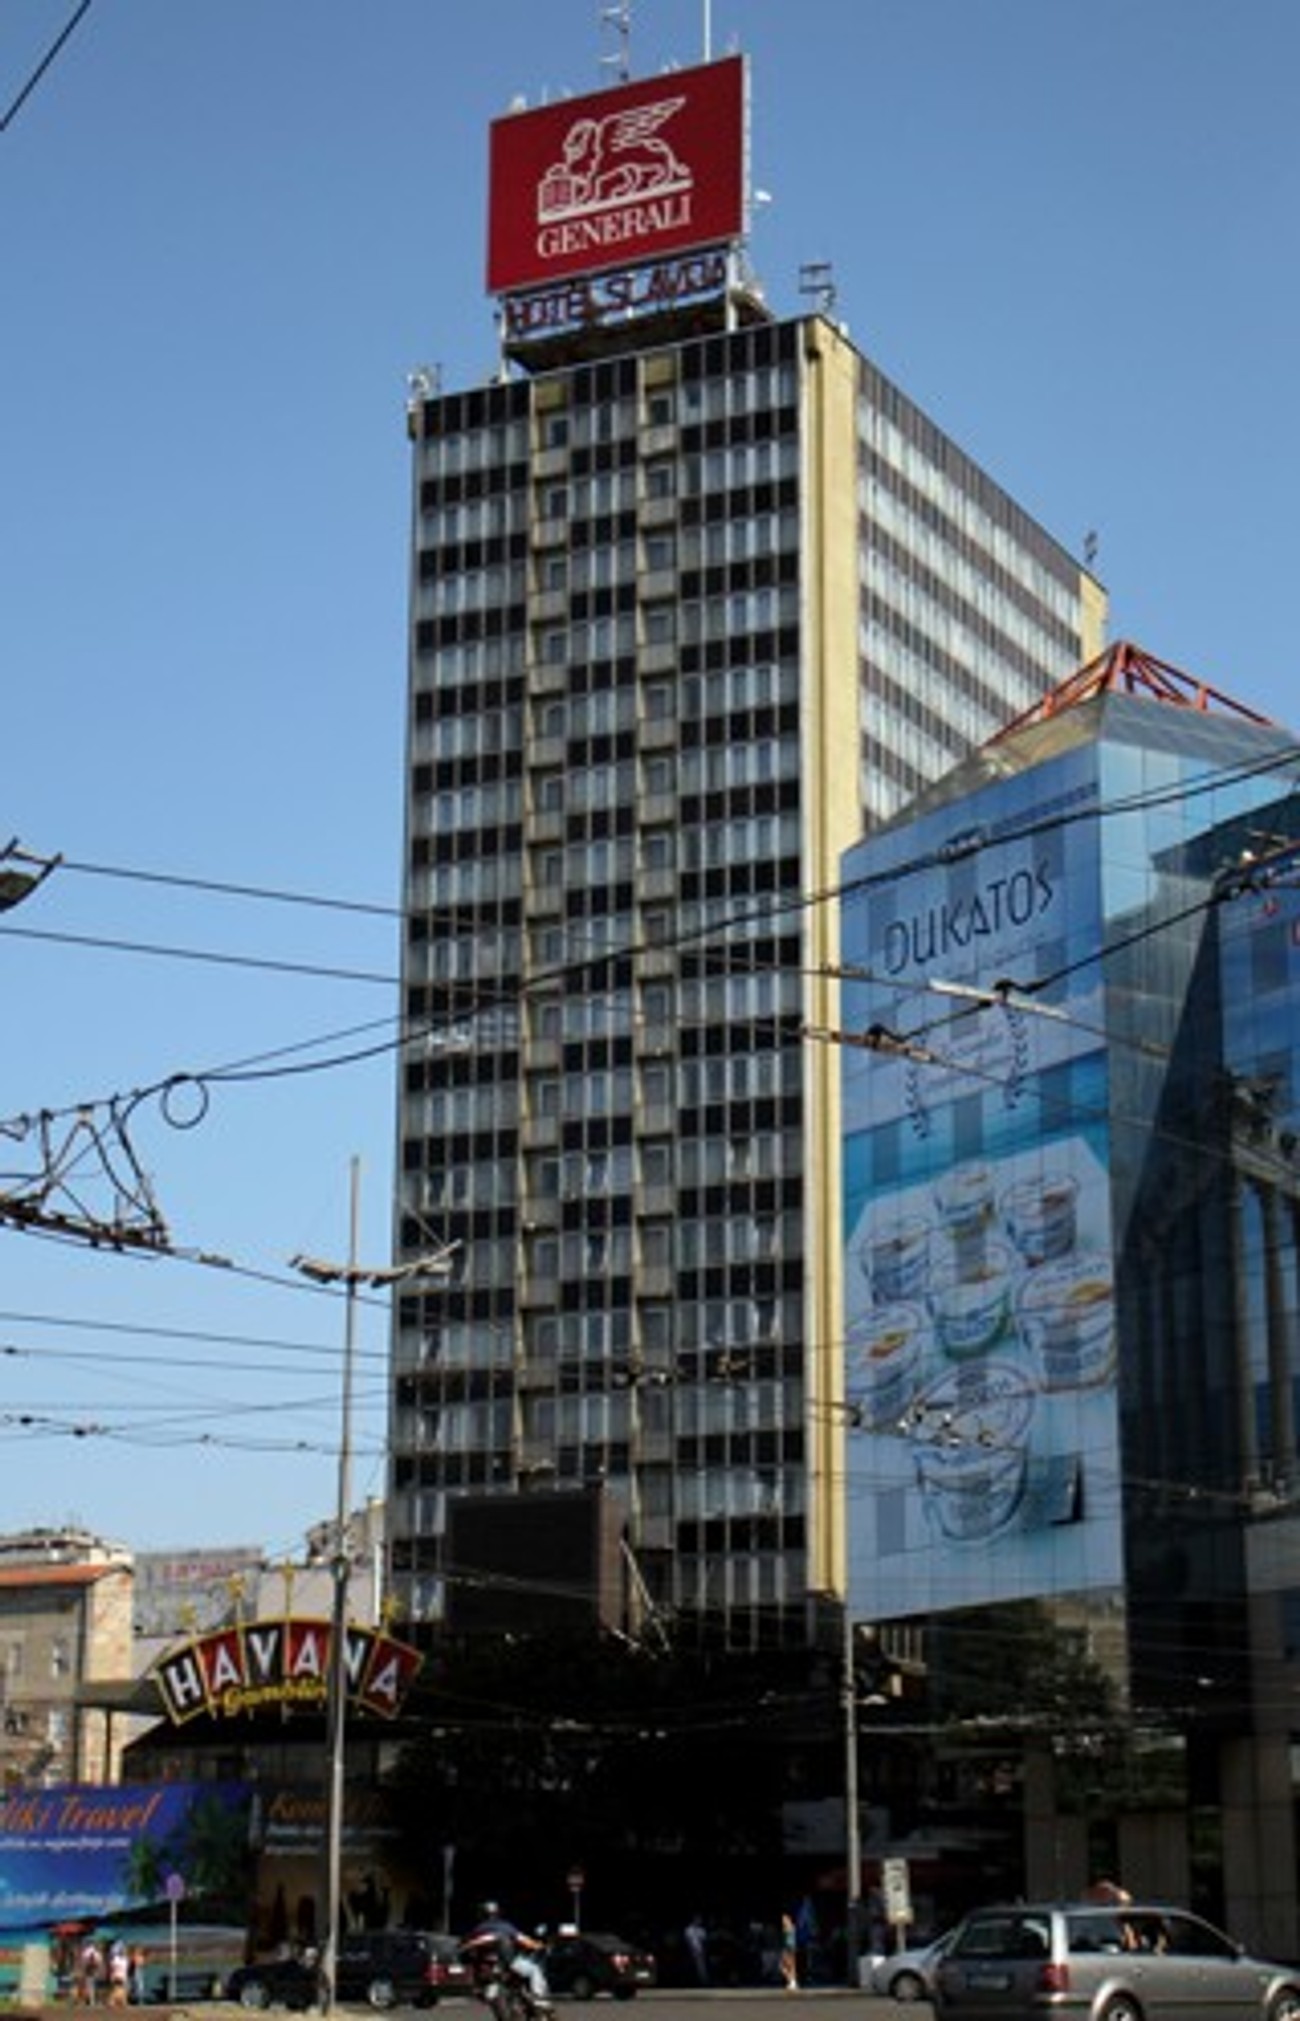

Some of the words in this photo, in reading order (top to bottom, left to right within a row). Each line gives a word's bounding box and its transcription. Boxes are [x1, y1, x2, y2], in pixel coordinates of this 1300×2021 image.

[537, 196, 692, 257] GENERALI
[884, 861, 1054, 975] DUKATOS
[168, 1631, 402, 1707] HAVANA
[58, 1793, 163, 1834] Travel
